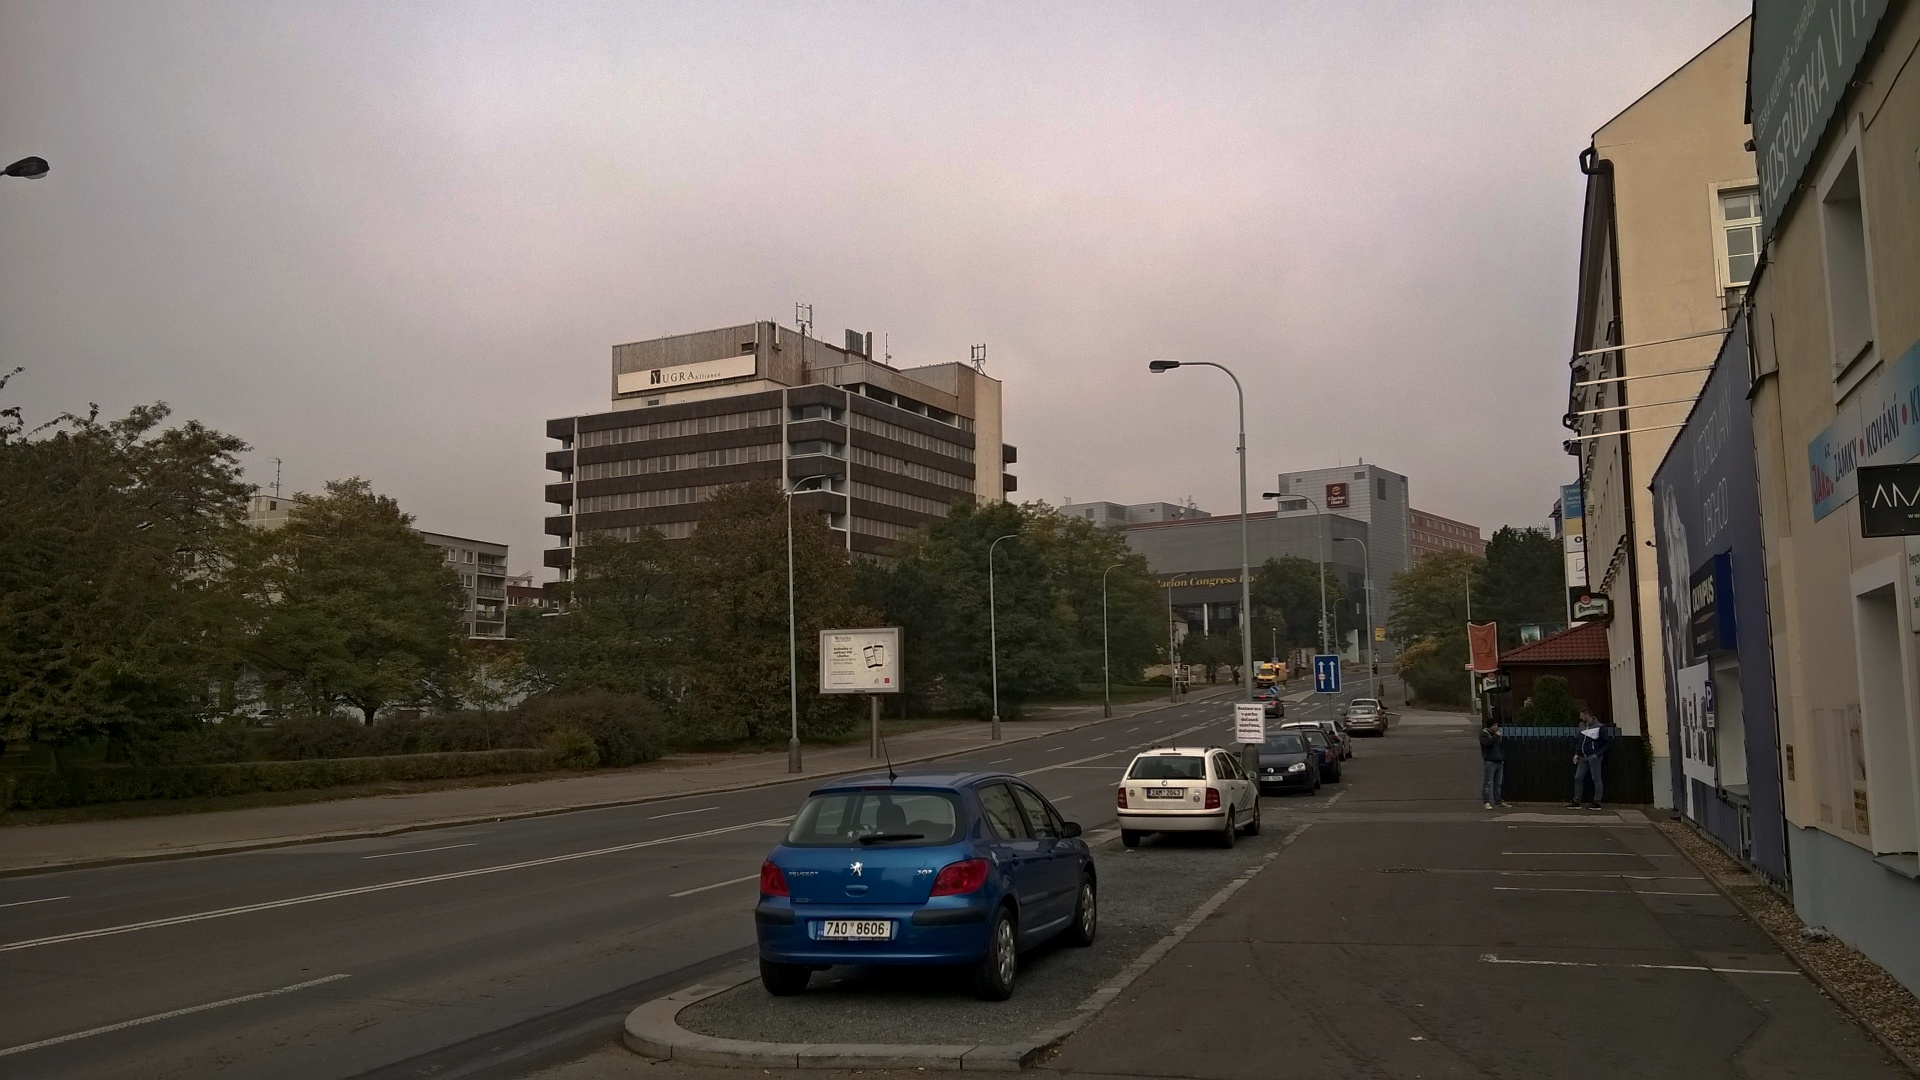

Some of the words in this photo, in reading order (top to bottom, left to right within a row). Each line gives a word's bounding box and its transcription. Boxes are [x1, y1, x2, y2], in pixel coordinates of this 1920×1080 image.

[1761, 35, 1830, 217] HOSPŮDKA
[1834, 437, 1858, 483] ZÁMKY
[1865, 393, 1900, 458] KOVÁNÍ
[1190, 577, 1236, 588] Congress
[1692, 574, 1715, 614] OLYMPUS
[1705, 685, 1712, 708] P
[856, 922, 885, 935] 8606
